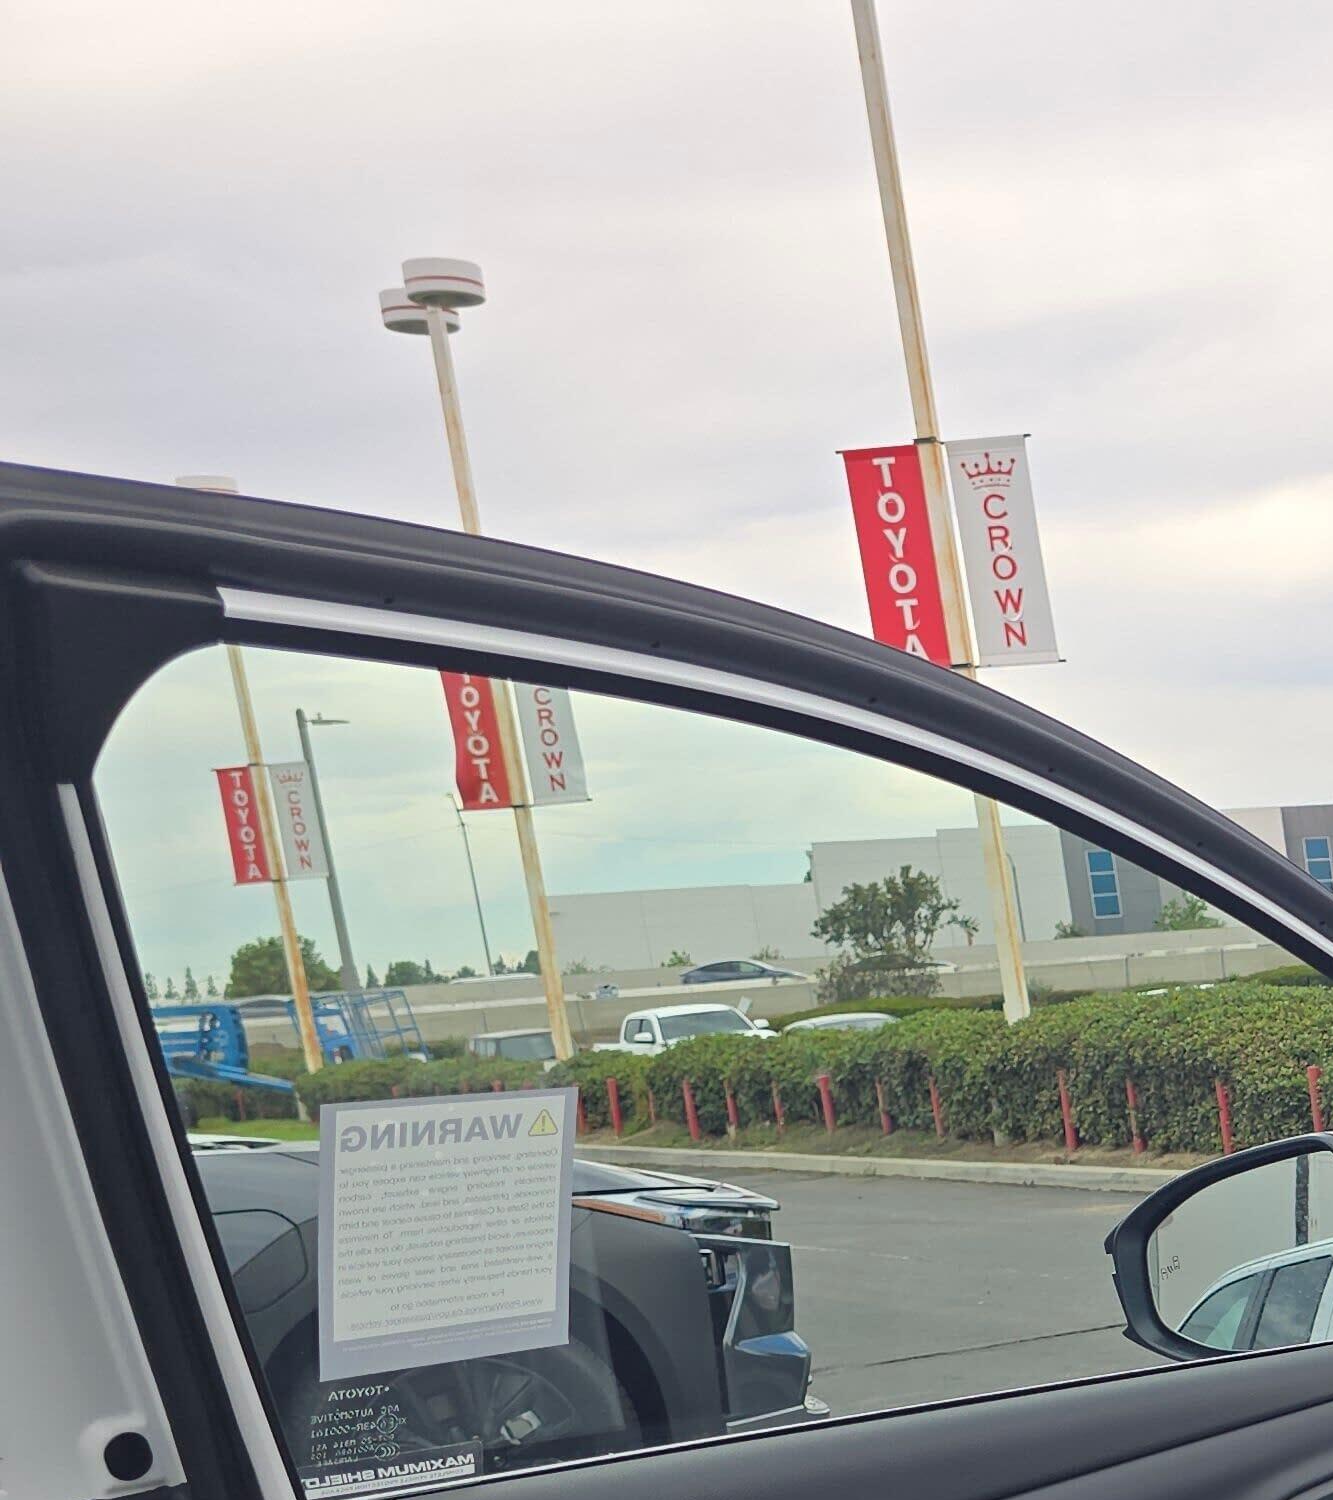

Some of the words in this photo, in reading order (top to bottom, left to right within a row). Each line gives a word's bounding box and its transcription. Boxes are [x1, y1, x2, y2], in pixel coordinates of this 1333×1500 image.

[871, 456, 930, 661] TOYOTA
[983, 494, 1029, 648] CROWN
[533, 687, 567, 793] CROWN
[229, 771, 263, 881] TOYOTA
[288, 789, 313, 871] CROWN
